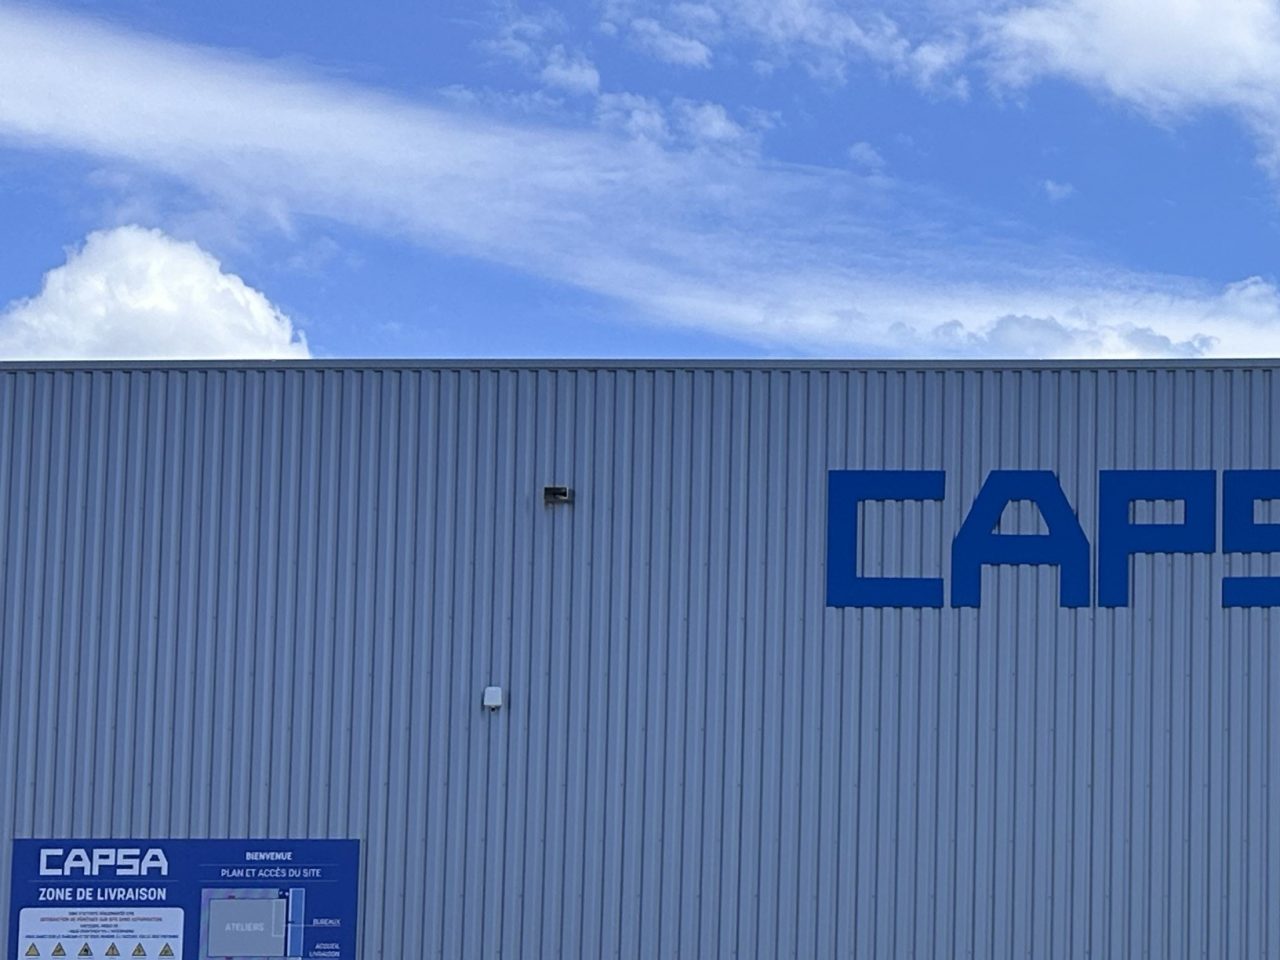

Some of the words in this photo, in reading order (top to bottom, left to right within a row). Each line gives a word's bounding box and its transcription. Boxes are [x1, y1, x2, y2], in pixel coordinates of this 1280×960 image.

[39, 848, 169, 876] CAPSA
[245, 852, 293, 861] BIENVENUE
[221, 868, 244, 877] PLAN
[245, 868, 257, 877] ET
[288, 868, 301, 877] DU
[302, 868, 322, 877] SITE
[38, 887, 73, 900] ZONE
[76, 887, 94, 900] DE
[97, 887, 167, 900] LIVRAISON
